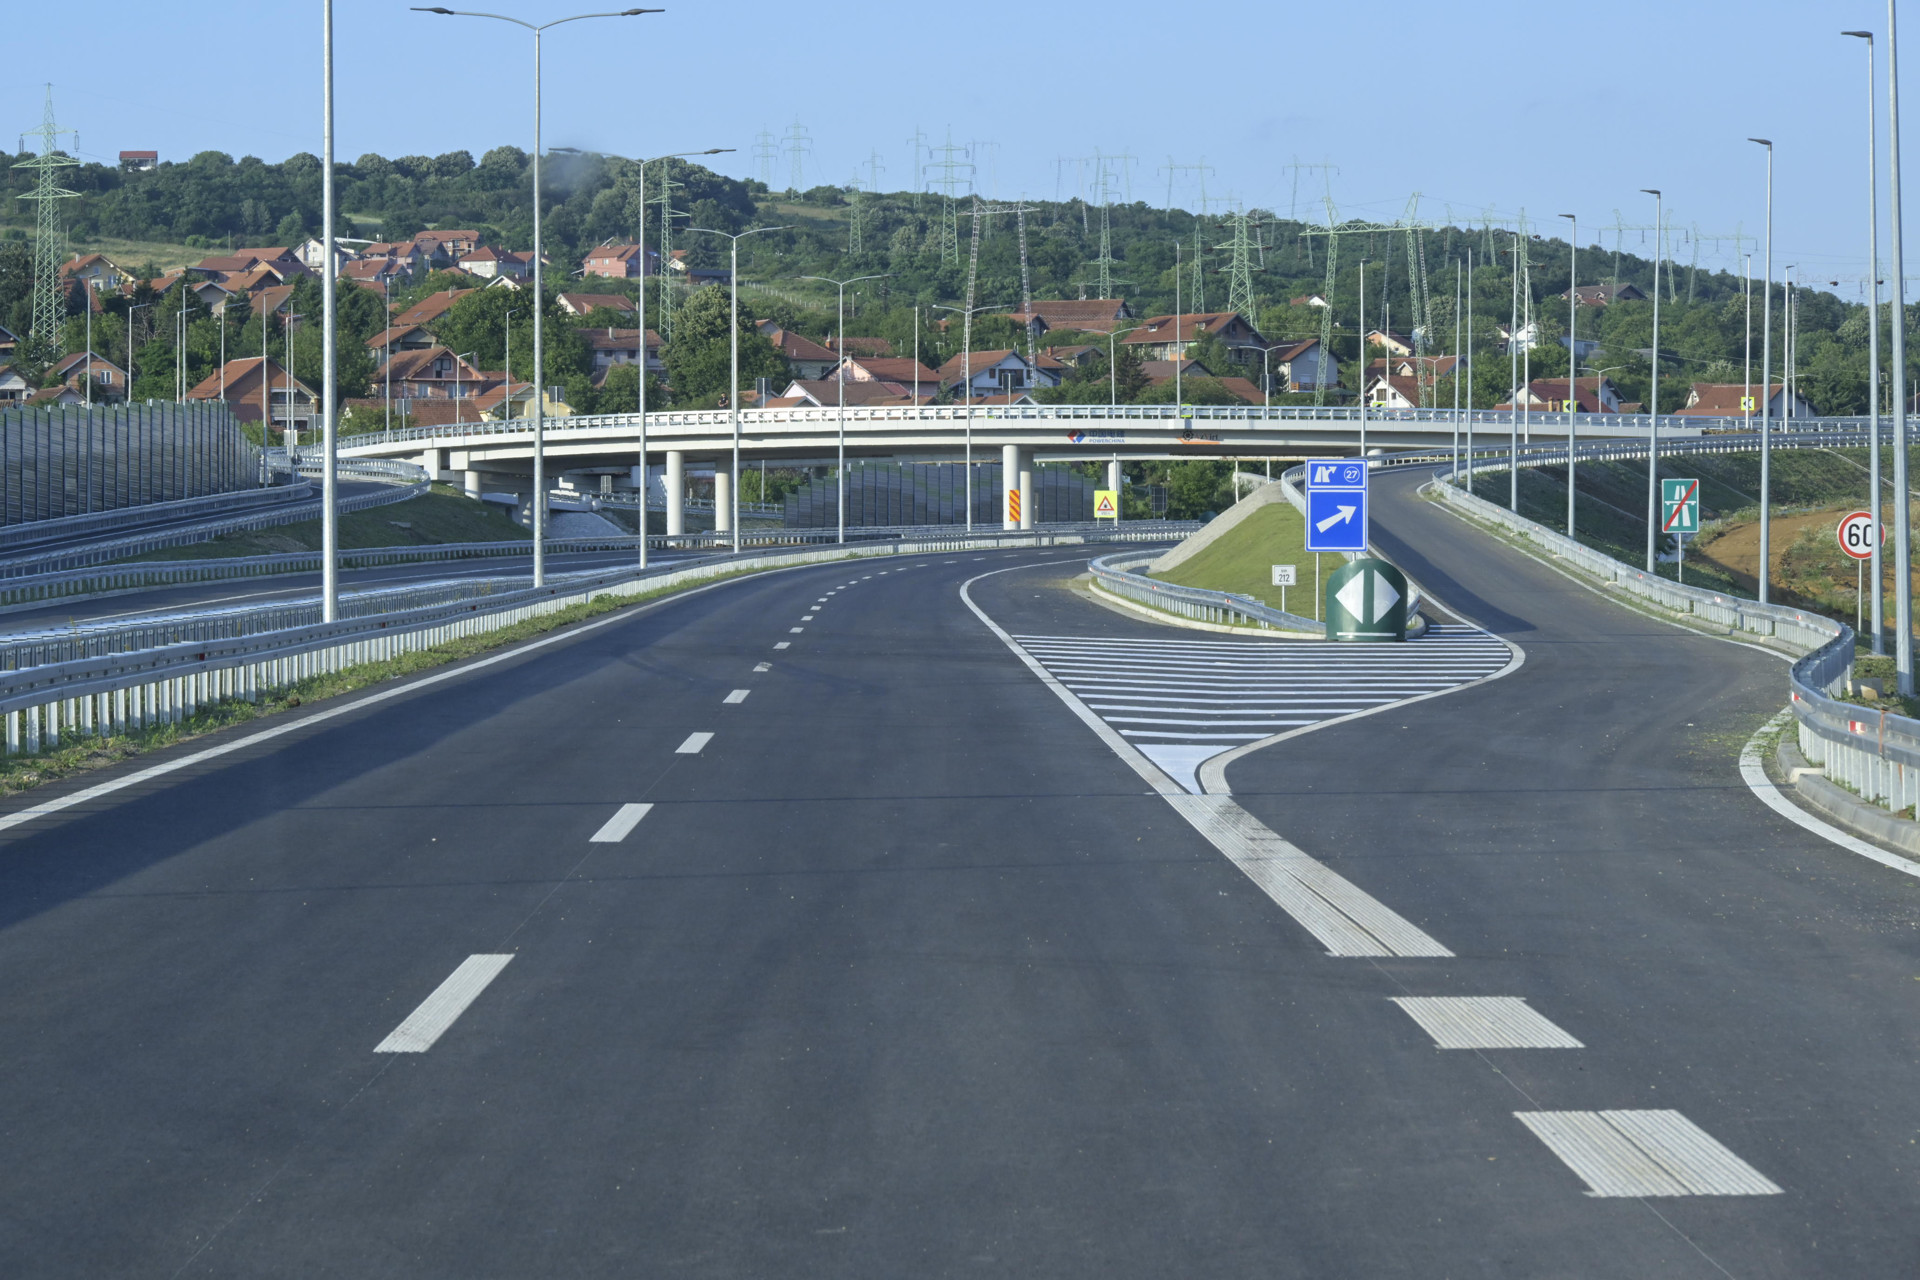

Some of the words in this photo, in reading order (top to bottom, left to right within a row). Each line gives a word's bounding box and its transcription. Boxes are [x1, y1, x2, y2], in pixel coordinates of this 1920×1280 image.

[1346, 470, 1358, 479] 27
[1848, 523, 1872, 547] 60
[1278, 573, 1290, 582] 212
